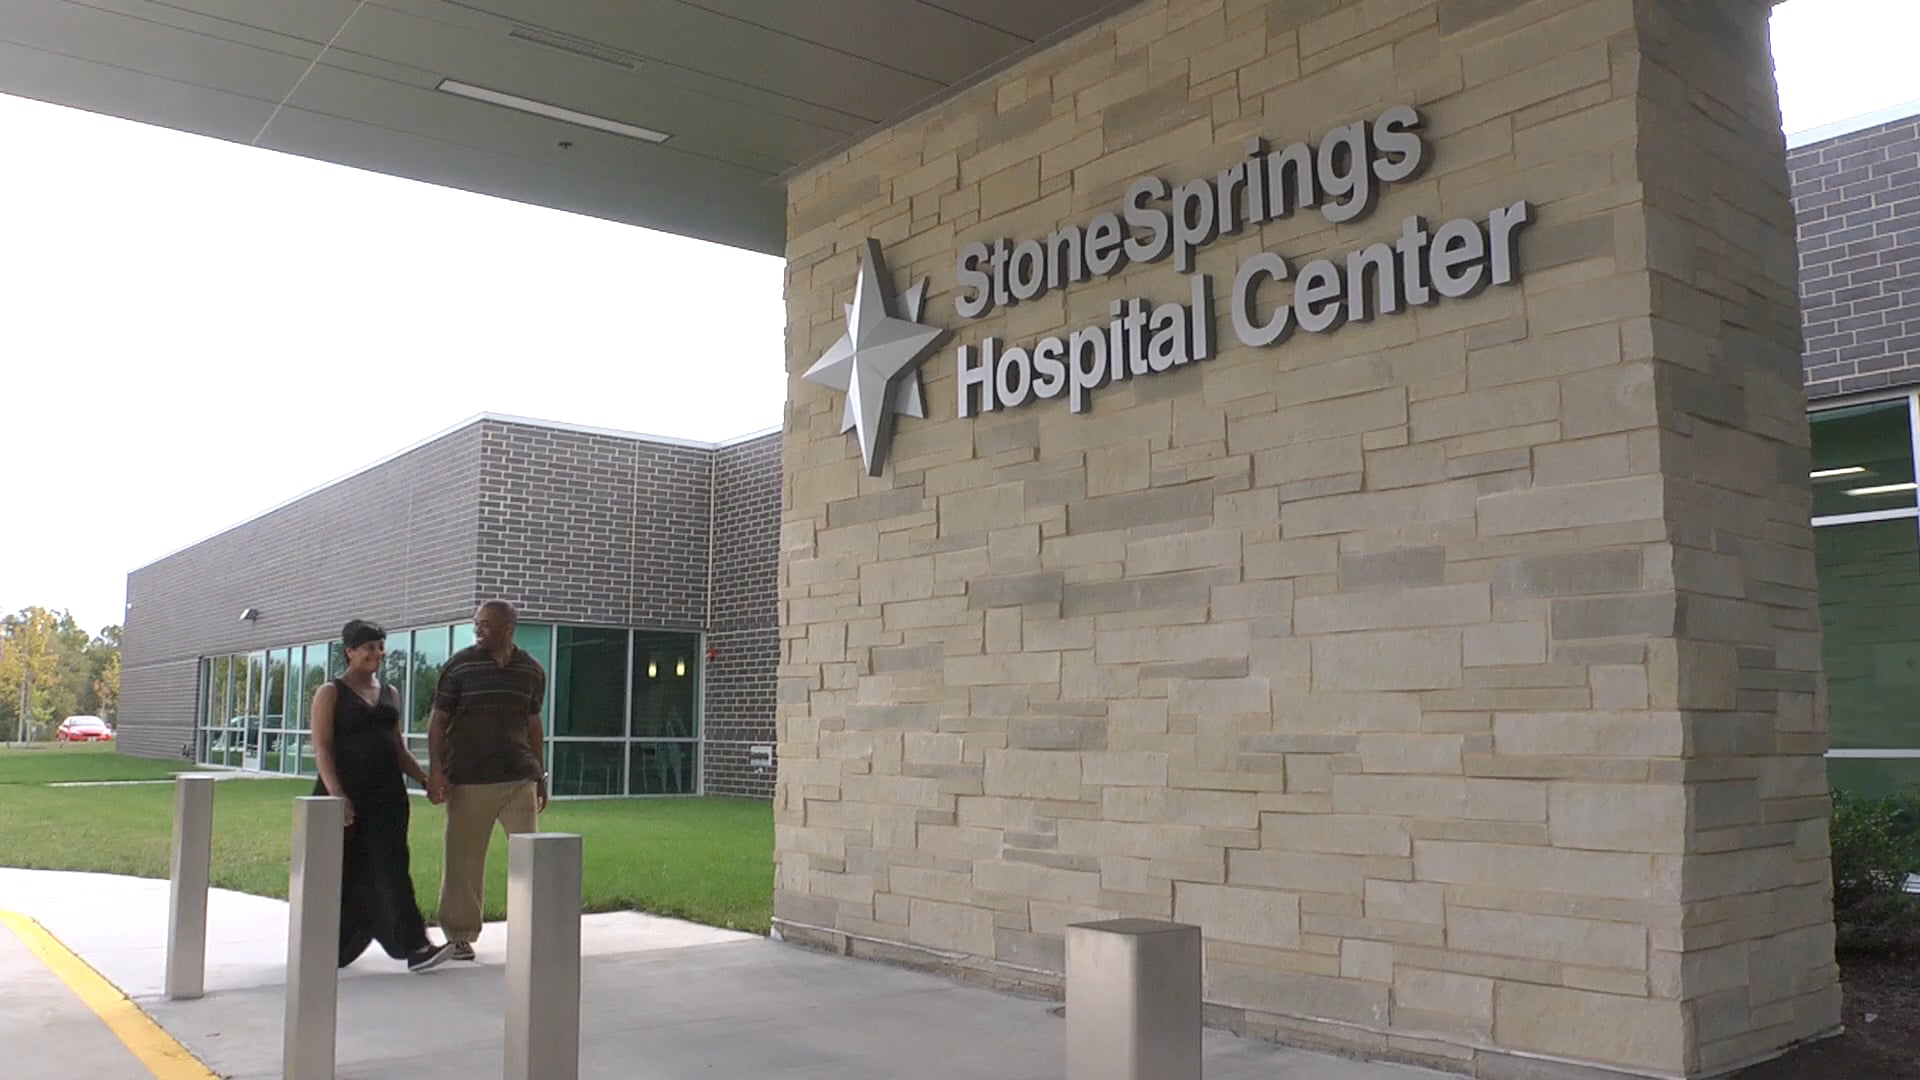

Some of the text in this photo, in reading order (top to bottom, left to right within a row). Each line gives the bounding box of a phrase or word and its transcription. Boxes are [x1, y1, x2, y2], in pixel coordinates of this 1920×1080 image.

[956, 105, 1425, 318] StoneSprings
[957, 200, 1530, 417] Hospital Center
